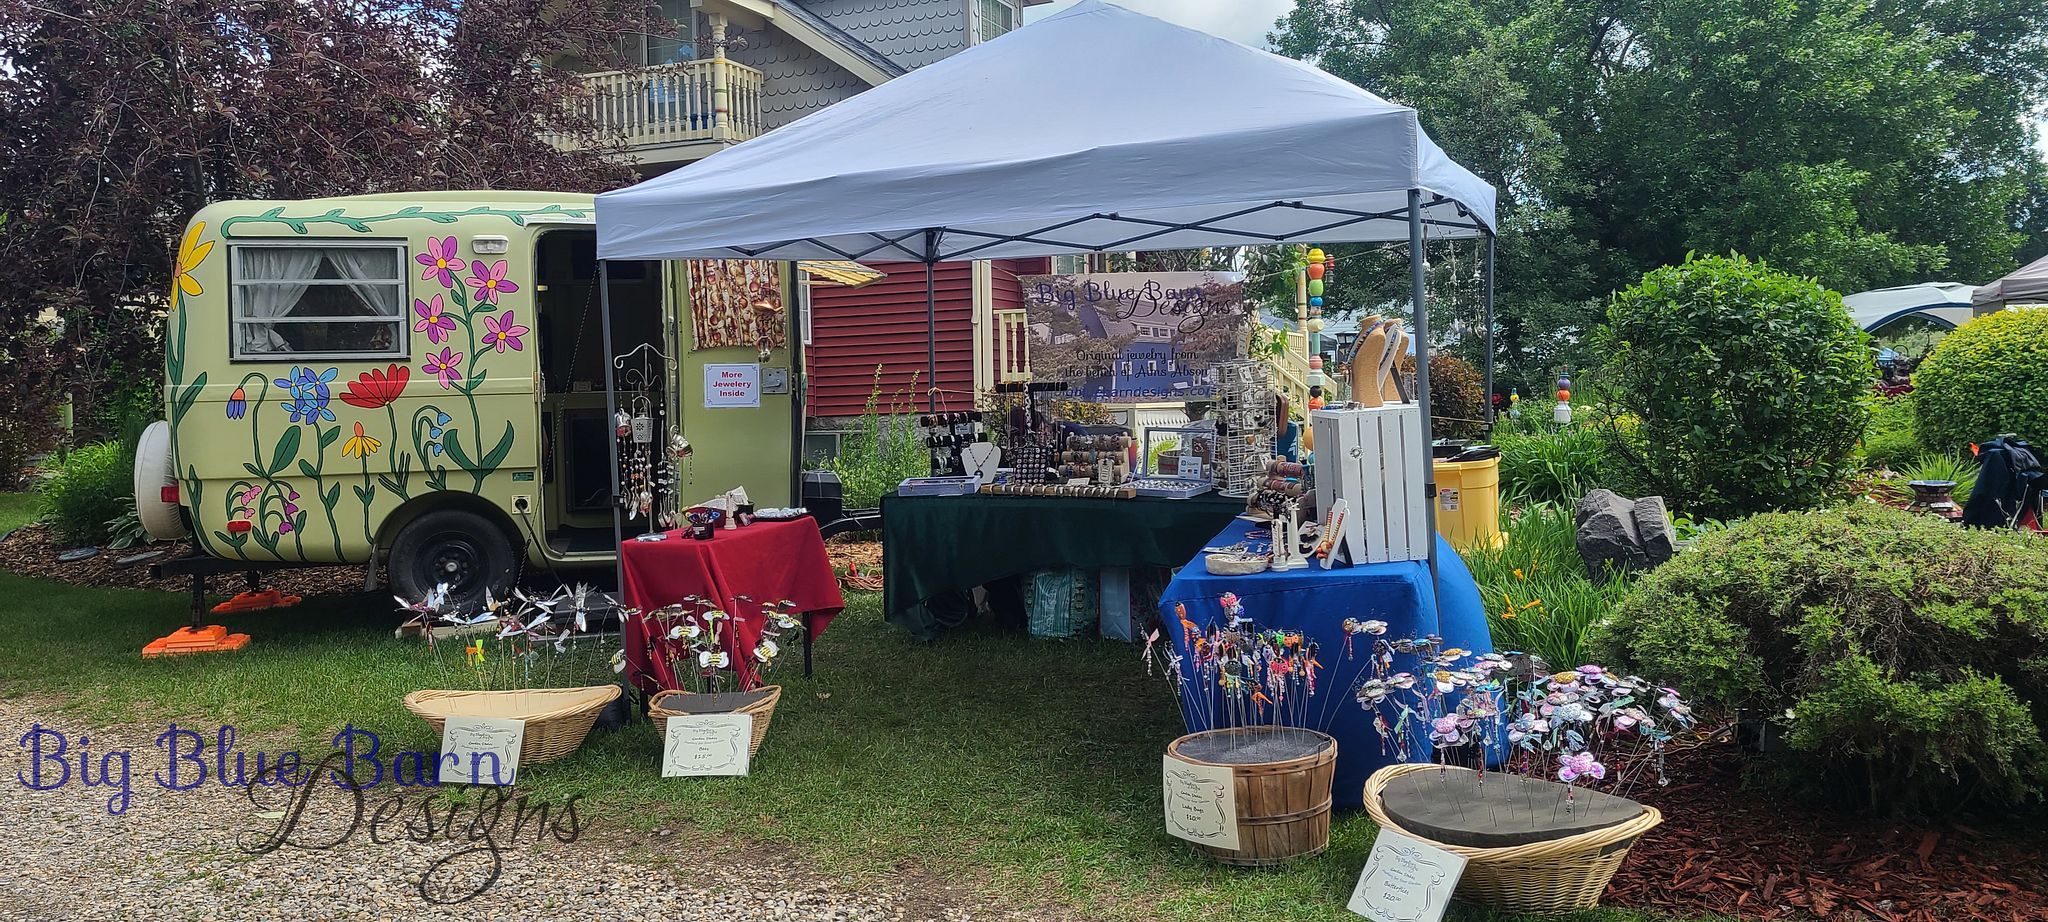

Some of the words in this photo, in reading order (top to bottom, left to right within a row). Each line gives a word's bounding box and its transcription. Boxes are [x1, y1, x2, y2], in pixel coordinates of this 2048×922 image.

[1031, 282, 1075, 310] Big
[1083, 279, 1139, 301] Blue
[1143, 279, 1205, 301] Barn
[1116, 287, 1232, 333] Designs
[1076, 348, 1122, 362] Original
[1126, 348, 1167, 364] jewelry
[1169, 347, 1198, 364] from
[1065, 365, 1082, 377] the
[1085, 365, 1117, 377] bench
[1120, 364, 1131, 382] of
[712, 380, 752, 389] Jewelery
